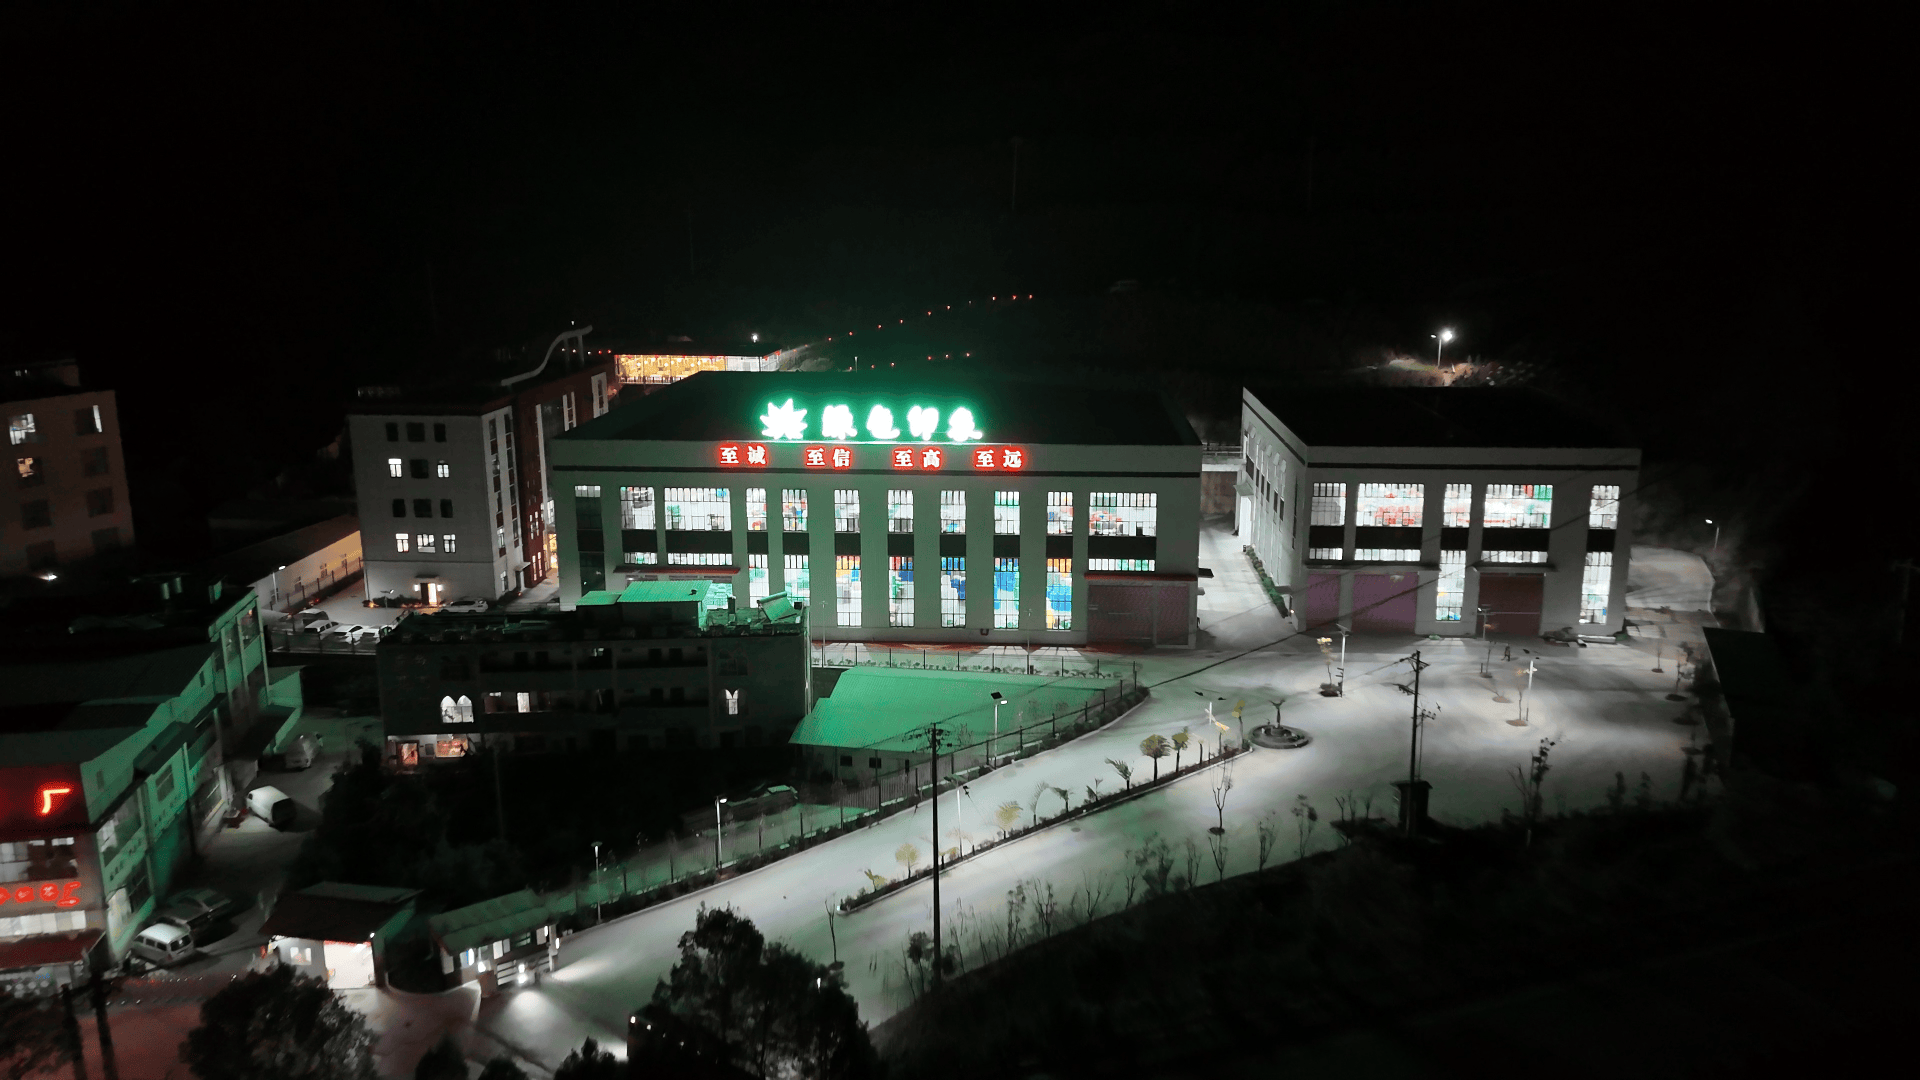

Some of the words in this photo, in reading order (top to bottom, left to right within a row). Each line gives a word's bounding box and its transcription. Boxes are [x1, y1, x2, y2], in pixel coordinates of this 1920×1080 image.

[719, 446, 767, 465] 至诚
[806, 447, 852, 467] 至信
[893, 448, 942, 468] 至高
[975, 449, 1023, 468] 至远
